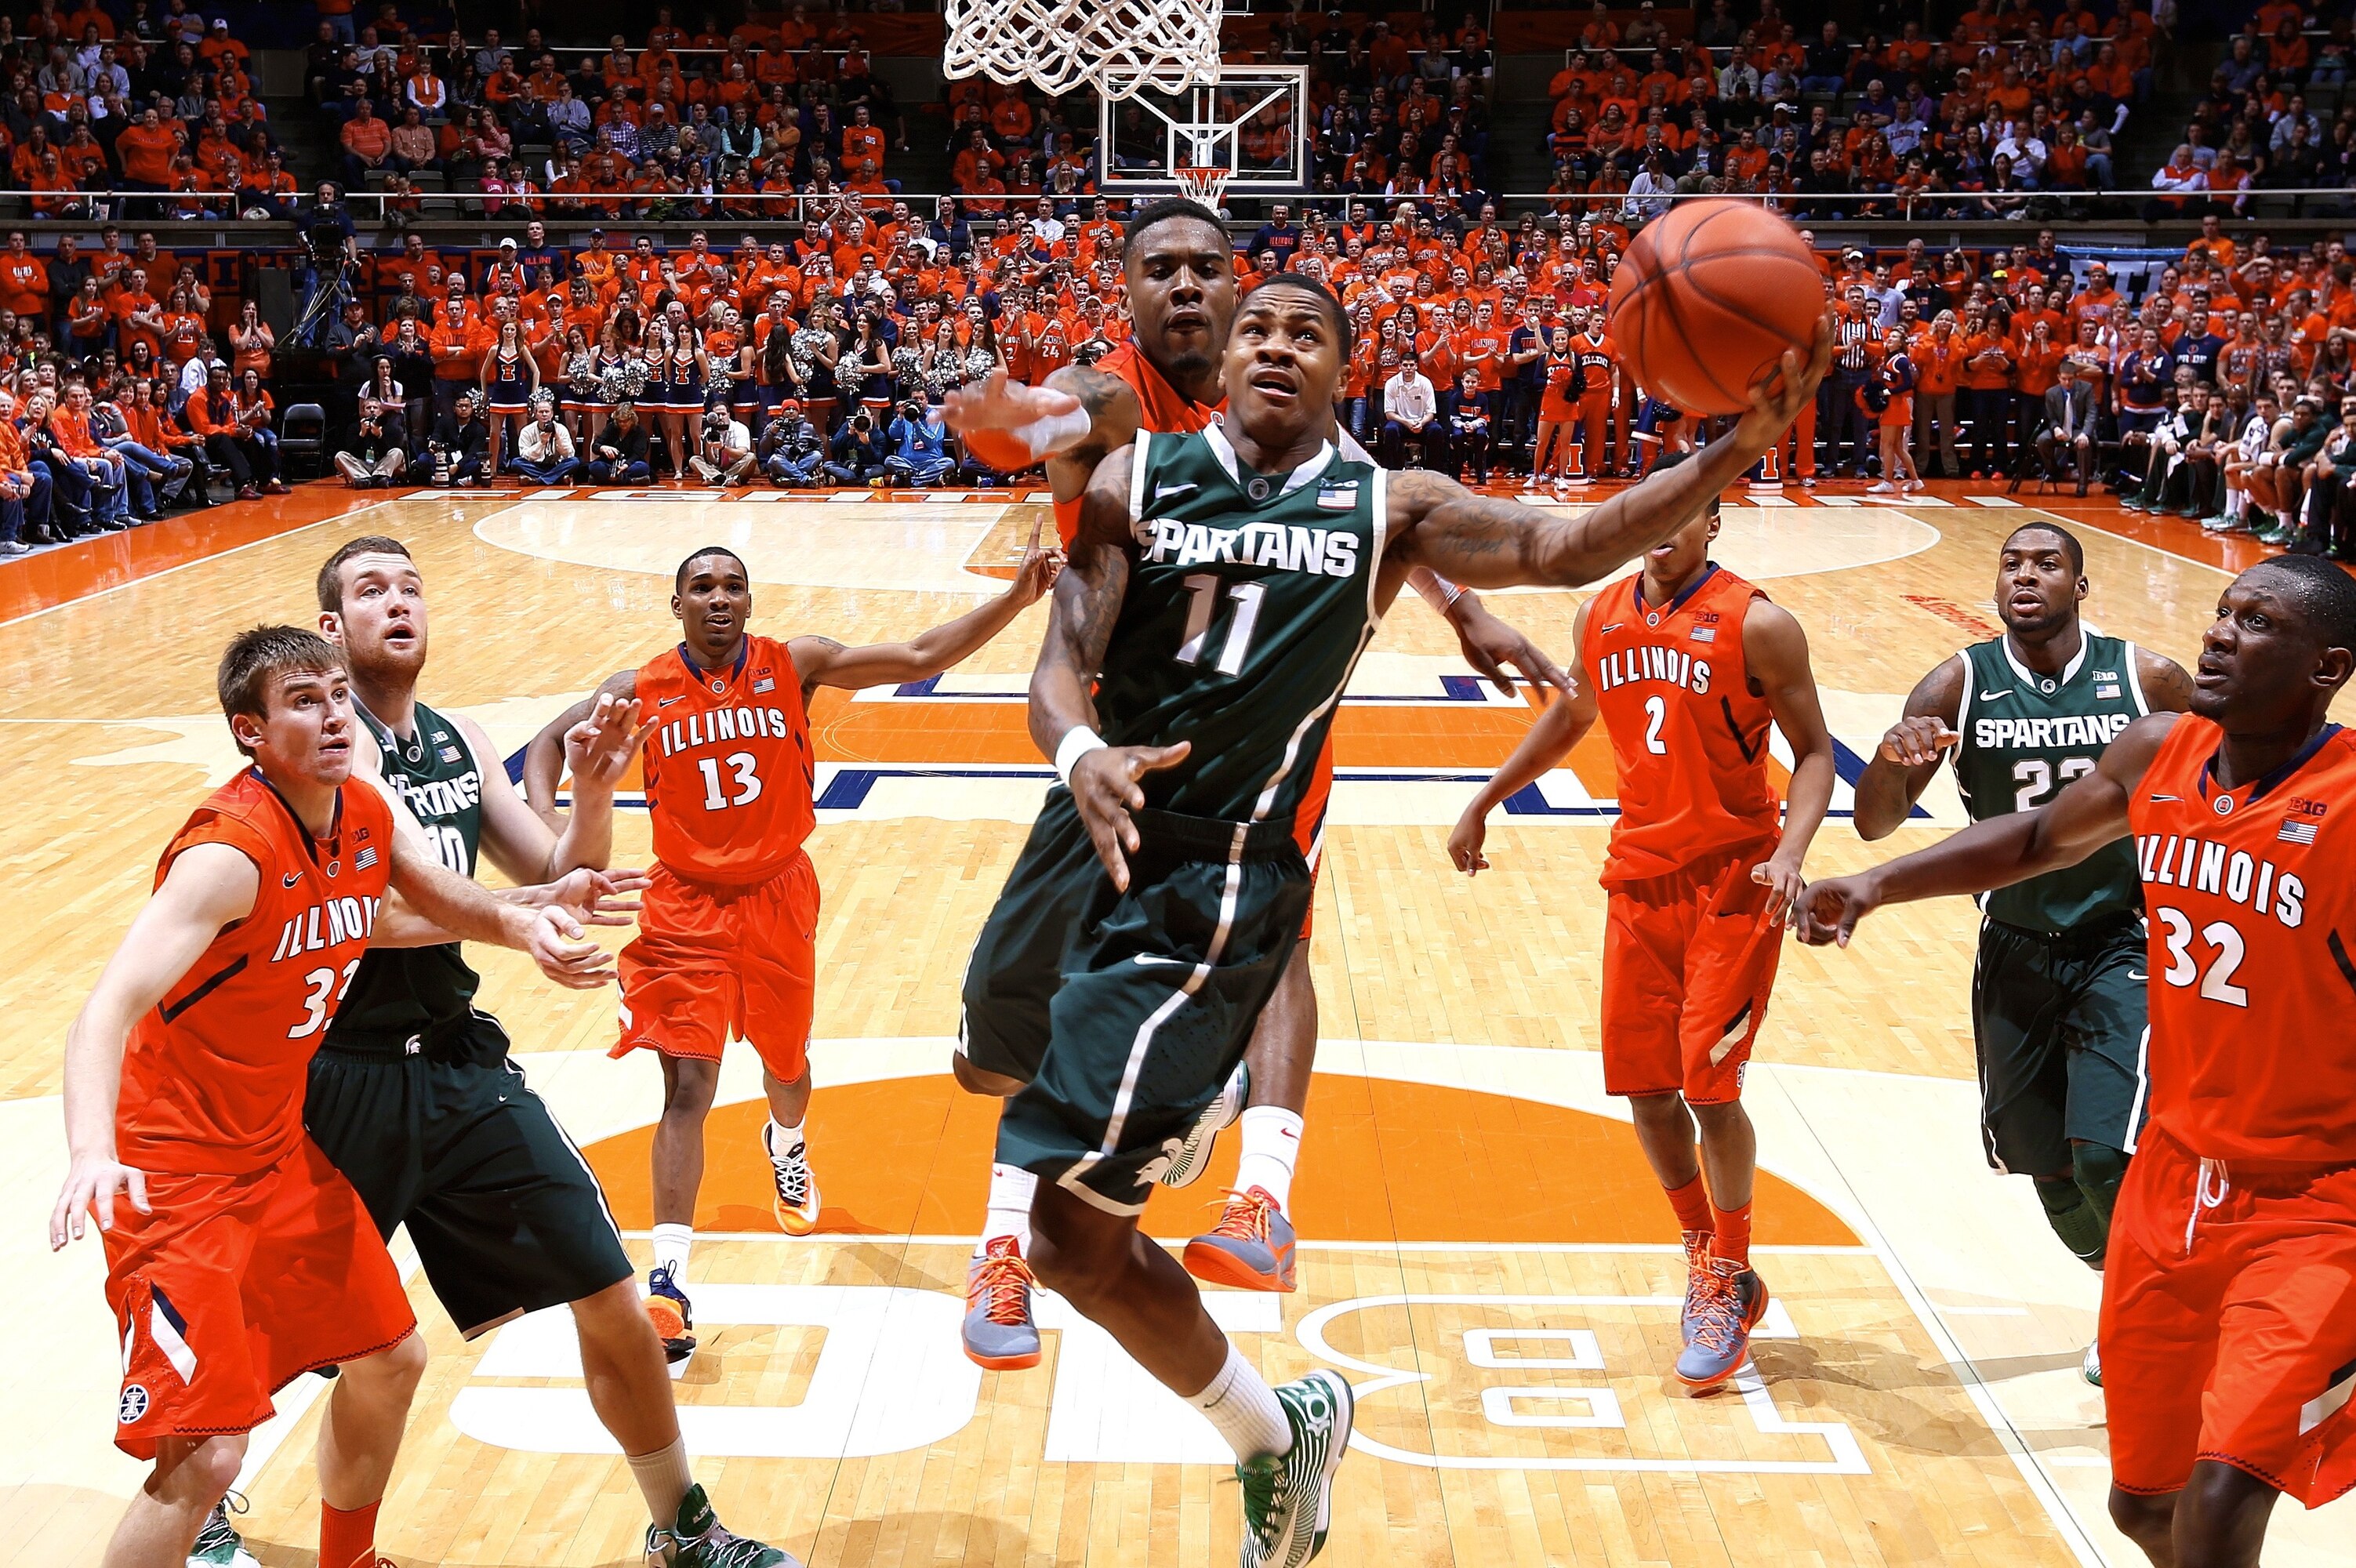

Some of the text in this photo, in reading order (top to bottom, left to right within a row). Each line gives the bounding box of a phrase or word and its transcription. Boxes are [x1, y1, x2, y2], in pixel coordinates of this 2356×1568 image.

[525, 256, 551, 265] ILLINI
[501, 364, 516, 382] I
[675, 365, 690, 385] I
[1005, 347, 1014, 360] 2
[1041, 345, 1060, 358] 24
[1137, 517, 1360, 579] SPARTANS
[1173, 572, 1269, 680] 11
[1599, 645, 1712, 695] ILLINOIS
[660, 706, 787, 759] ILLINOIS
[1643, 695, 1668, 755] 2
[1975, 713, 2131, 749] SPARTANS
[697, 750, 764, 811] 13
[2286, 796, 2328, 817] B1G
[2130, 833, 2305, 929] ILLINOIS
[2155, 905, 2249, 1008] 32
